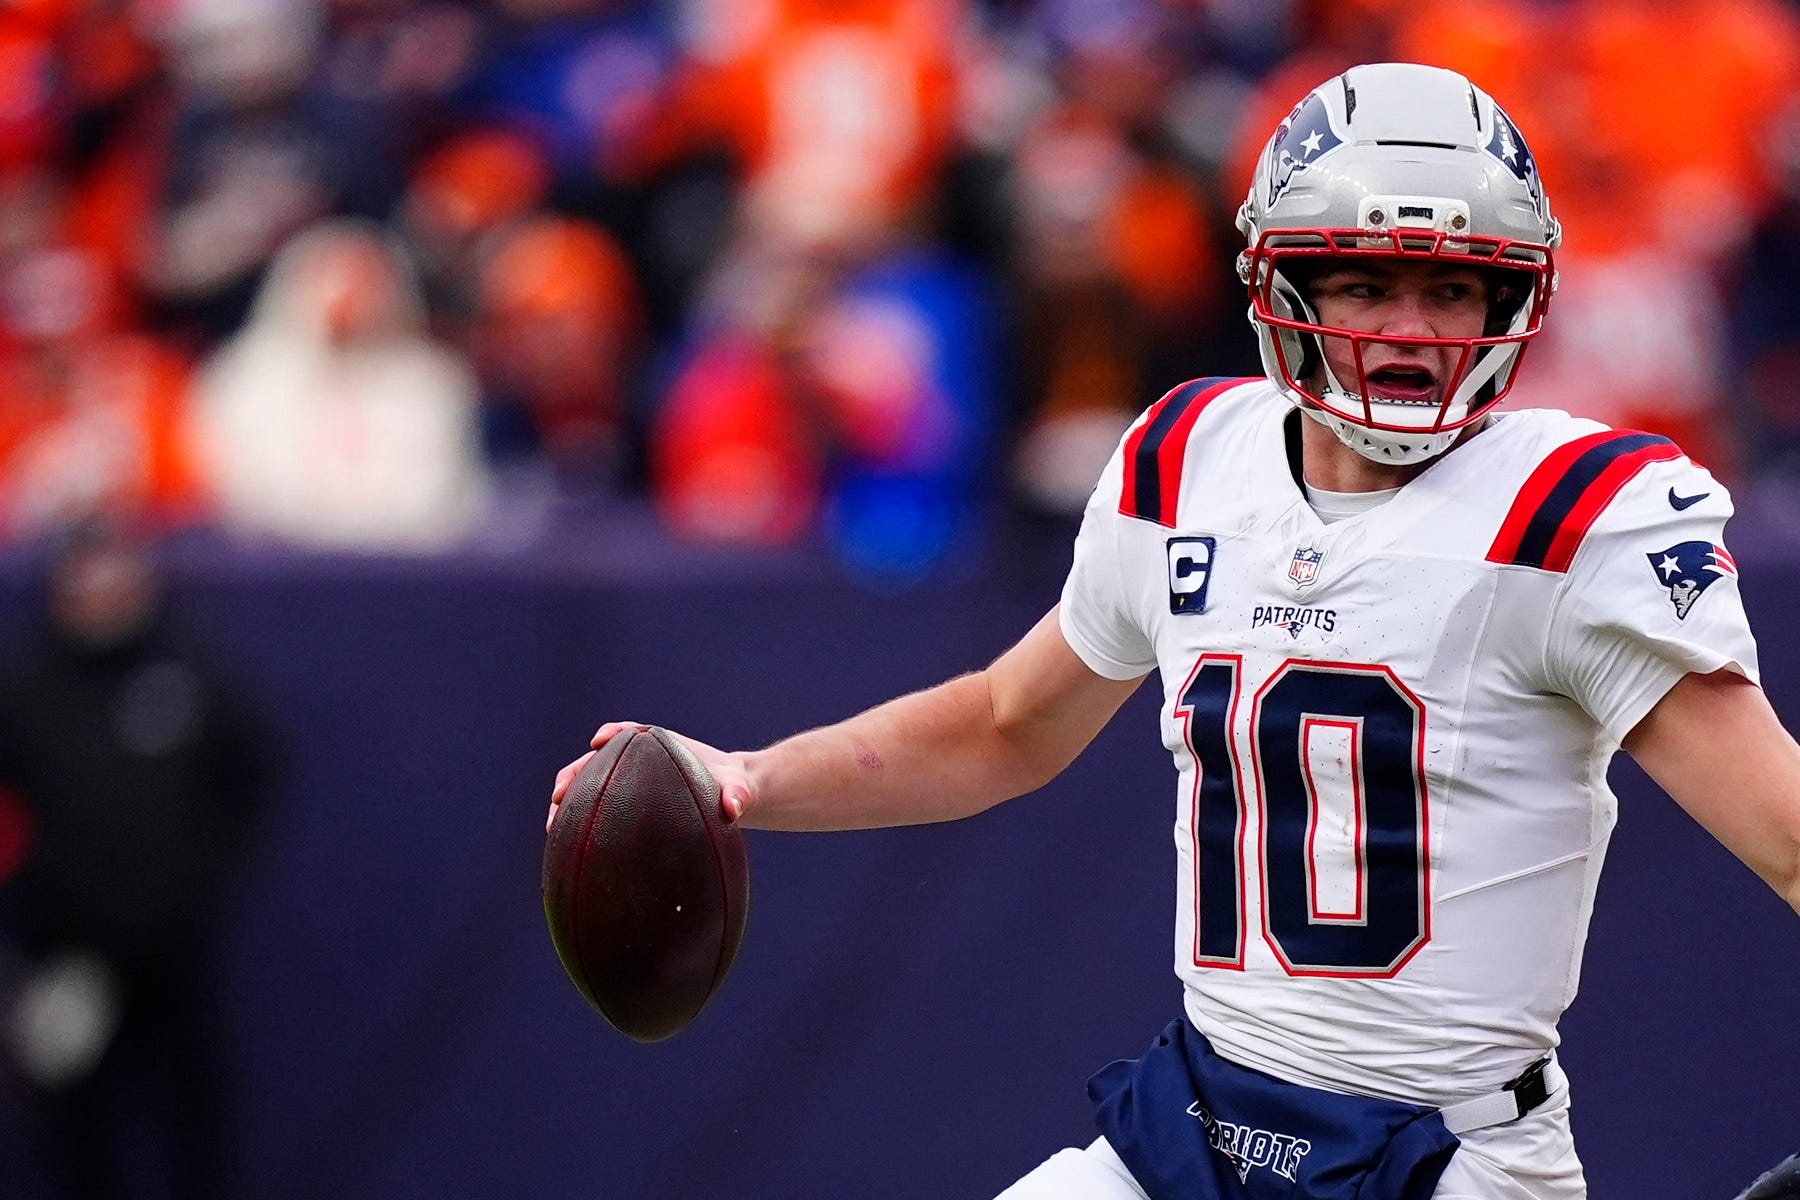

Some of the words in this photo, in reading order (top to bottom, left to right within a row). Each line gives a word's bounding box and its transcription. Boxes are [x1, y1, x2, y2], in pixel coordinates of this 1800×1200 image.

[1168, 542, 1209, 594] C
[1252, 606, 1337, 632] PATRIOTS
[1174, 653, 1432, 979] 10
